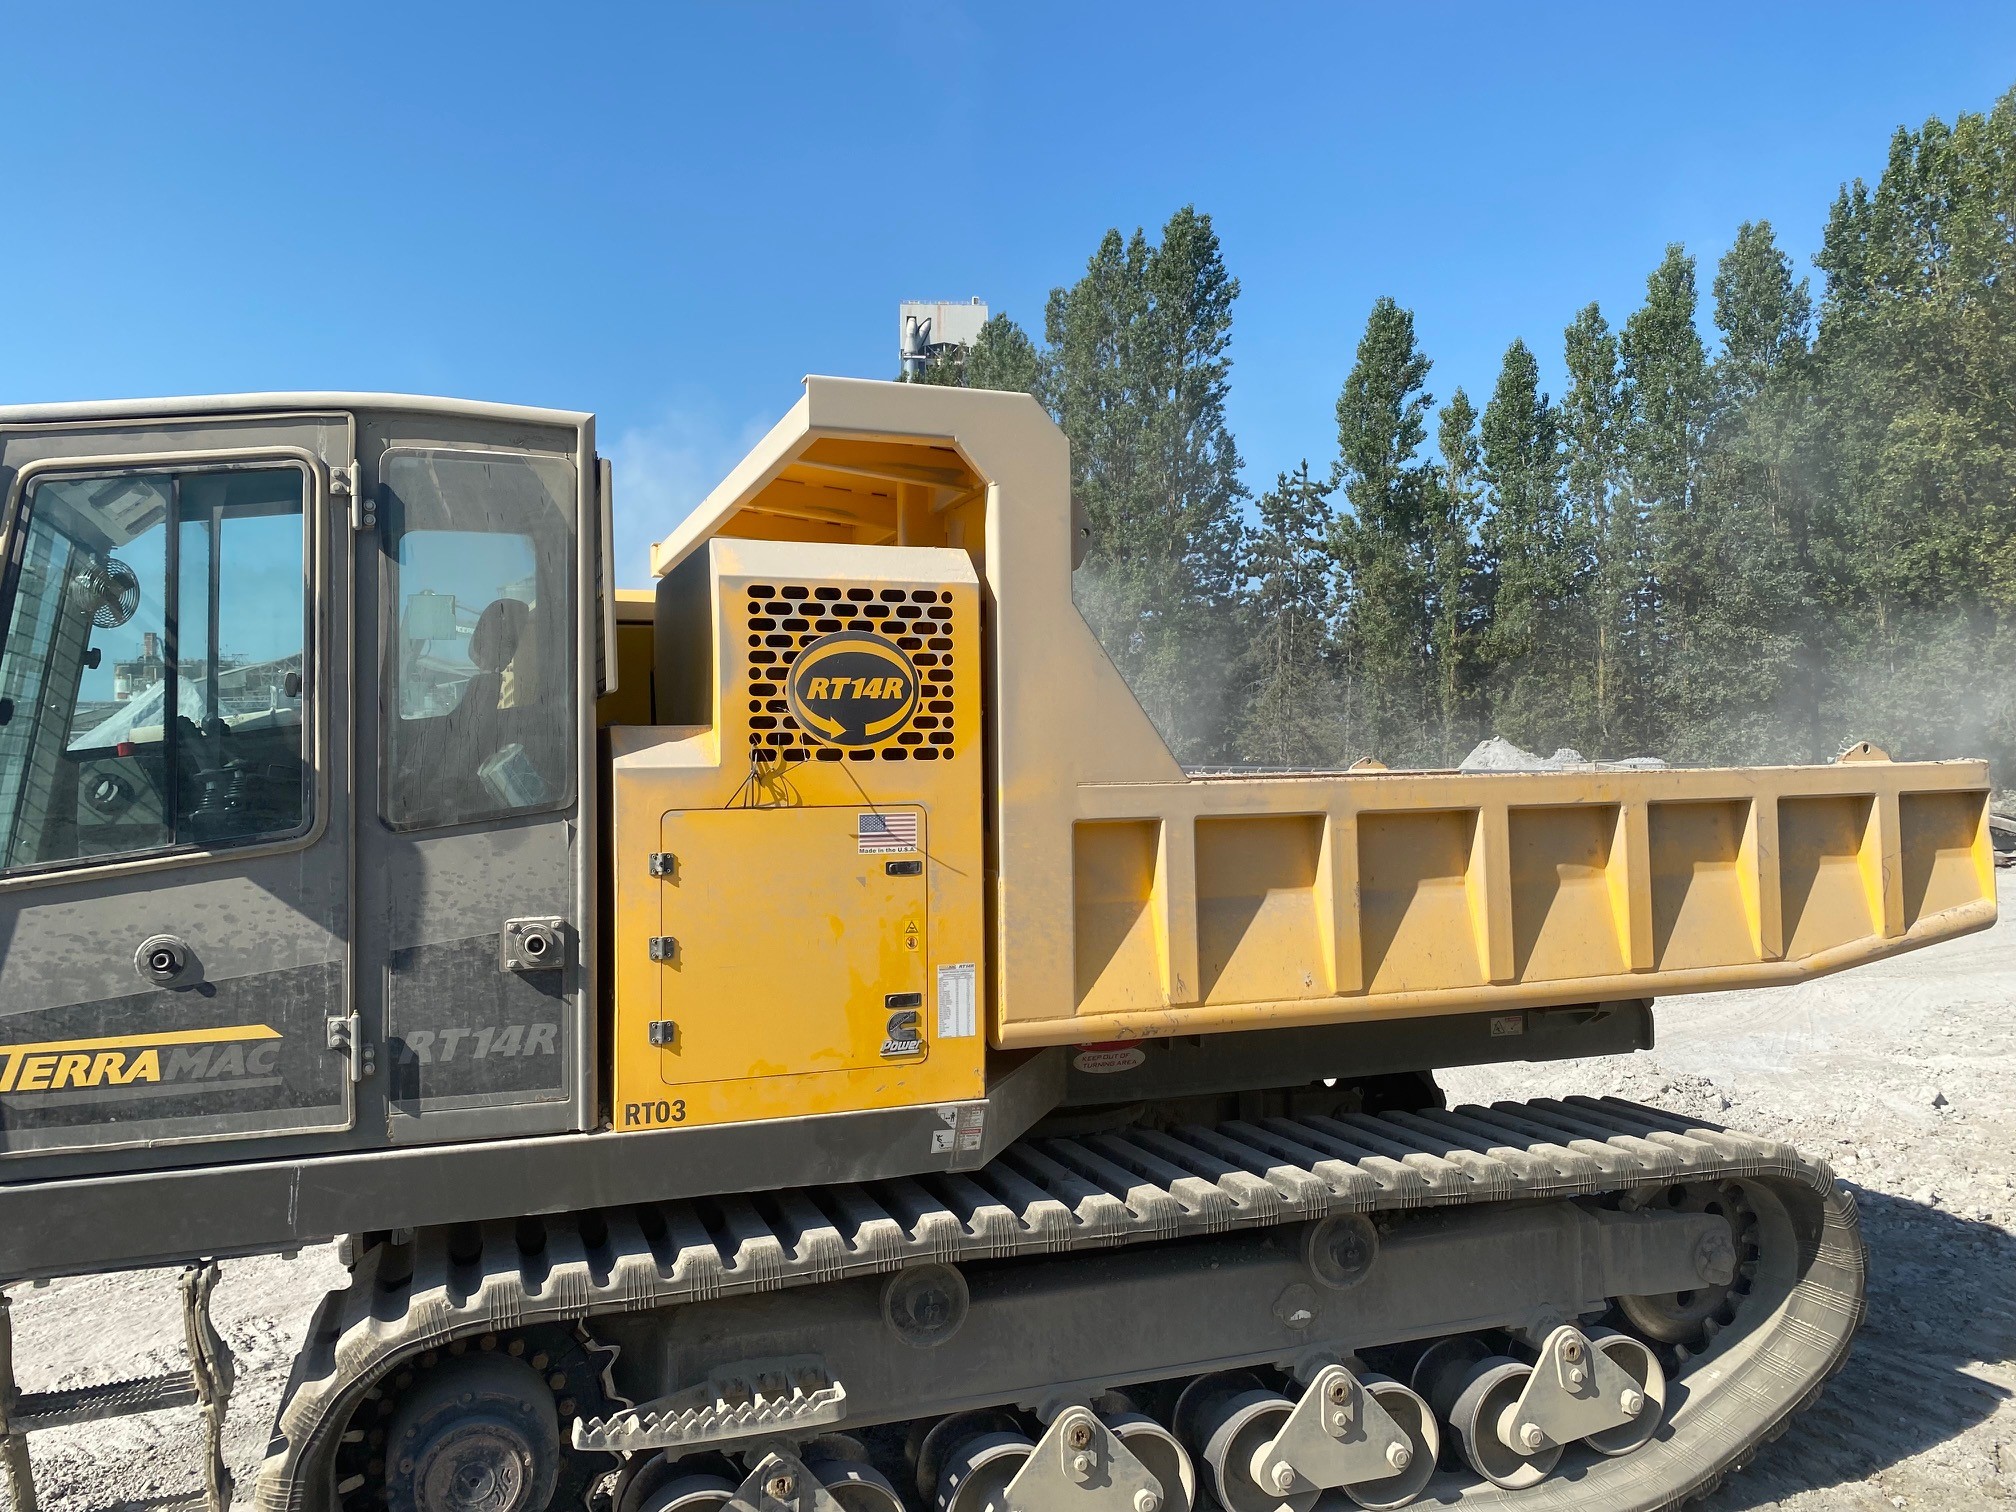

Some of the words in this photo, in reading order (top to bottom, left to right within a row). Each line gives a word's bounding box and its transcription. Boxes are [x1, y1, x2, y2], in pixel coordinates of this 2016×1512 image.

[806, 677, 904, 700] RT14R
[399, 1023, 558, 1064] RT14R
[1083, 1061, 1116, 1069] TURNING
[625, 1100, 686, 1126] RT03
